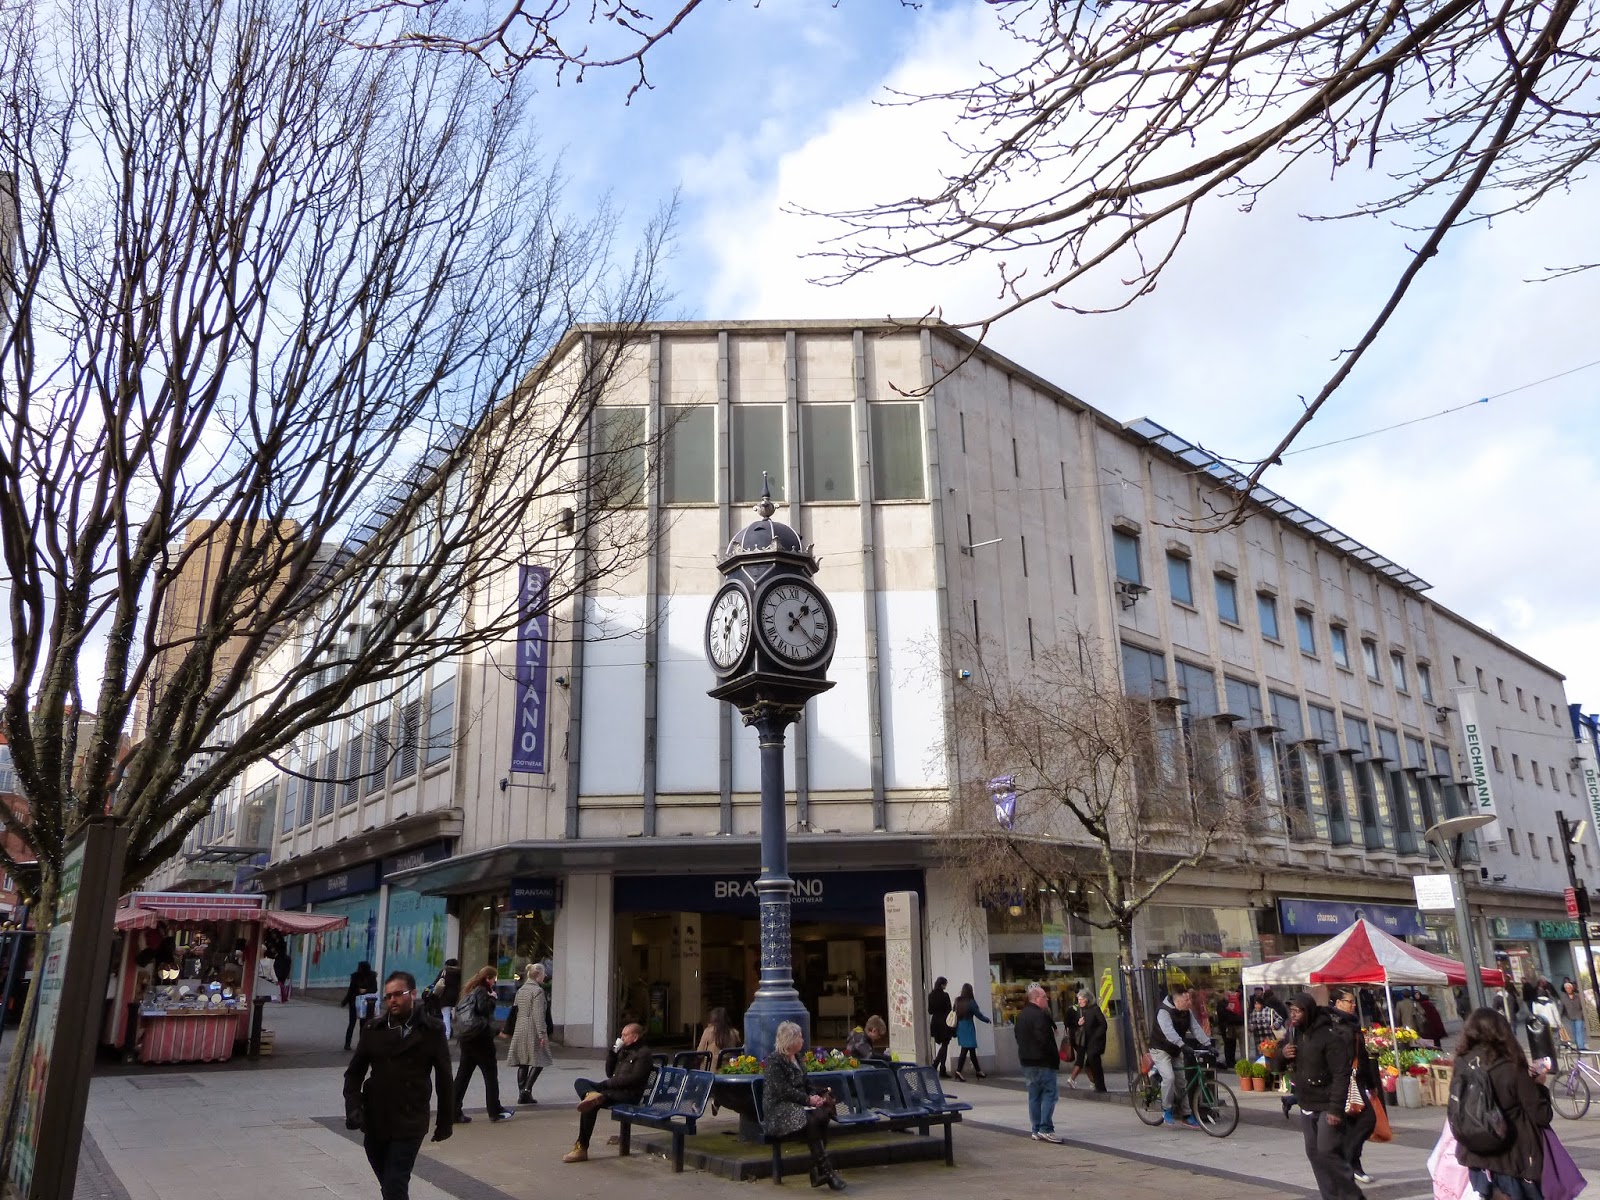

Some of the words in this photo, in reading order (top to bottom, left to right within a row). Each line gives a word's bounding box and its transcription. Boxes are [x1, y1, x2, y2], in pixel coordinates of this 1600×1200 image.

[513, 759, 542, 767] FOOTWEAR
[1466, 724, 1491, 807] DEICHMANN
[515, 888, 553, 897] BRANTANO
[790, 896, 823, 904] OOTWEAR
[1316, 912, 1338, 924] pharmacy
